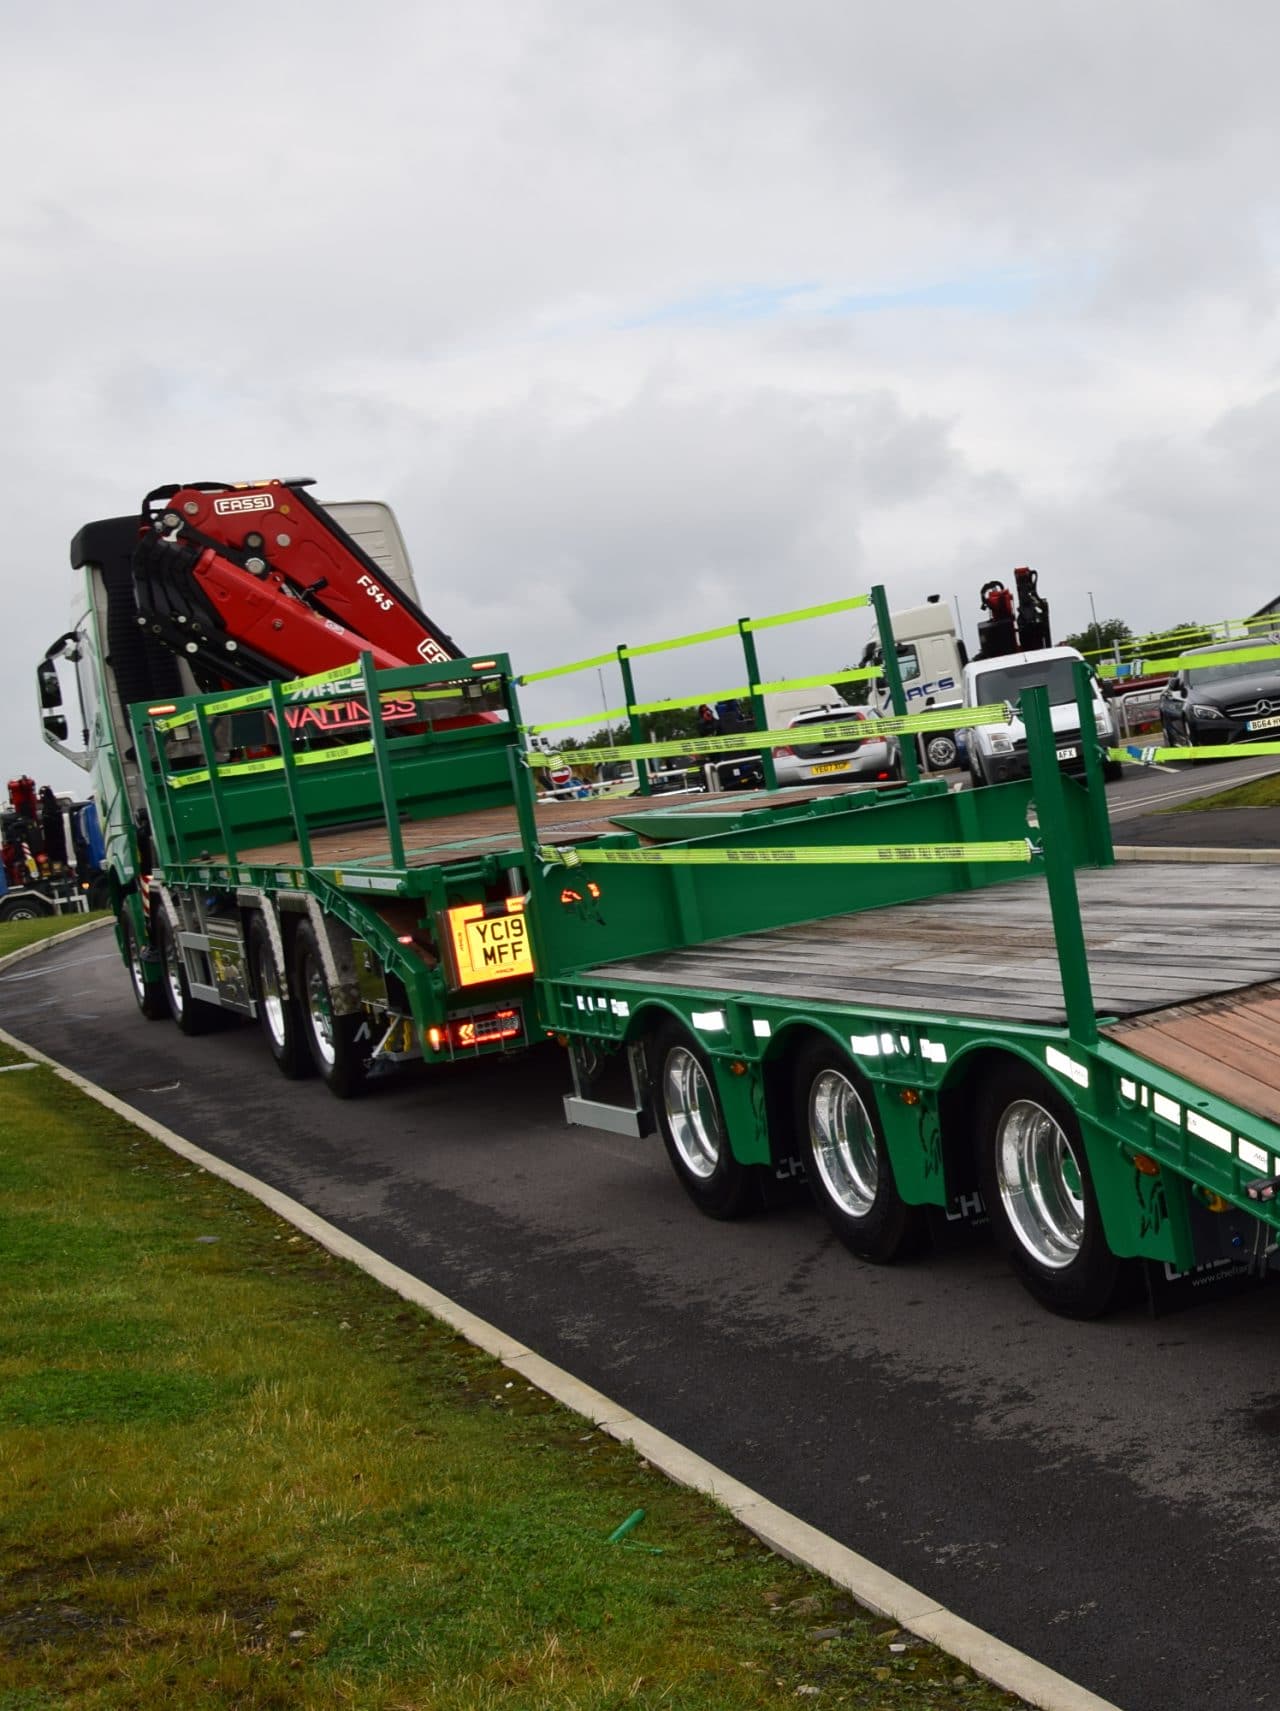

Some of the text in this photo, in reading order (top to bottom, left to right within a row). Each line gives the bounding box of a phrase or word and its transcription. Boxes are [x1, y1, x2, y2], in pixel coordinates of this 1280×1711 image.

[219, 497, 269, 512] FASSI
[357, 575, 394, 611] F545
[883, 677, 955, 710] ACS
[476, 918, 524, 943] YC19
[483, 941, 523, 966] MFF
